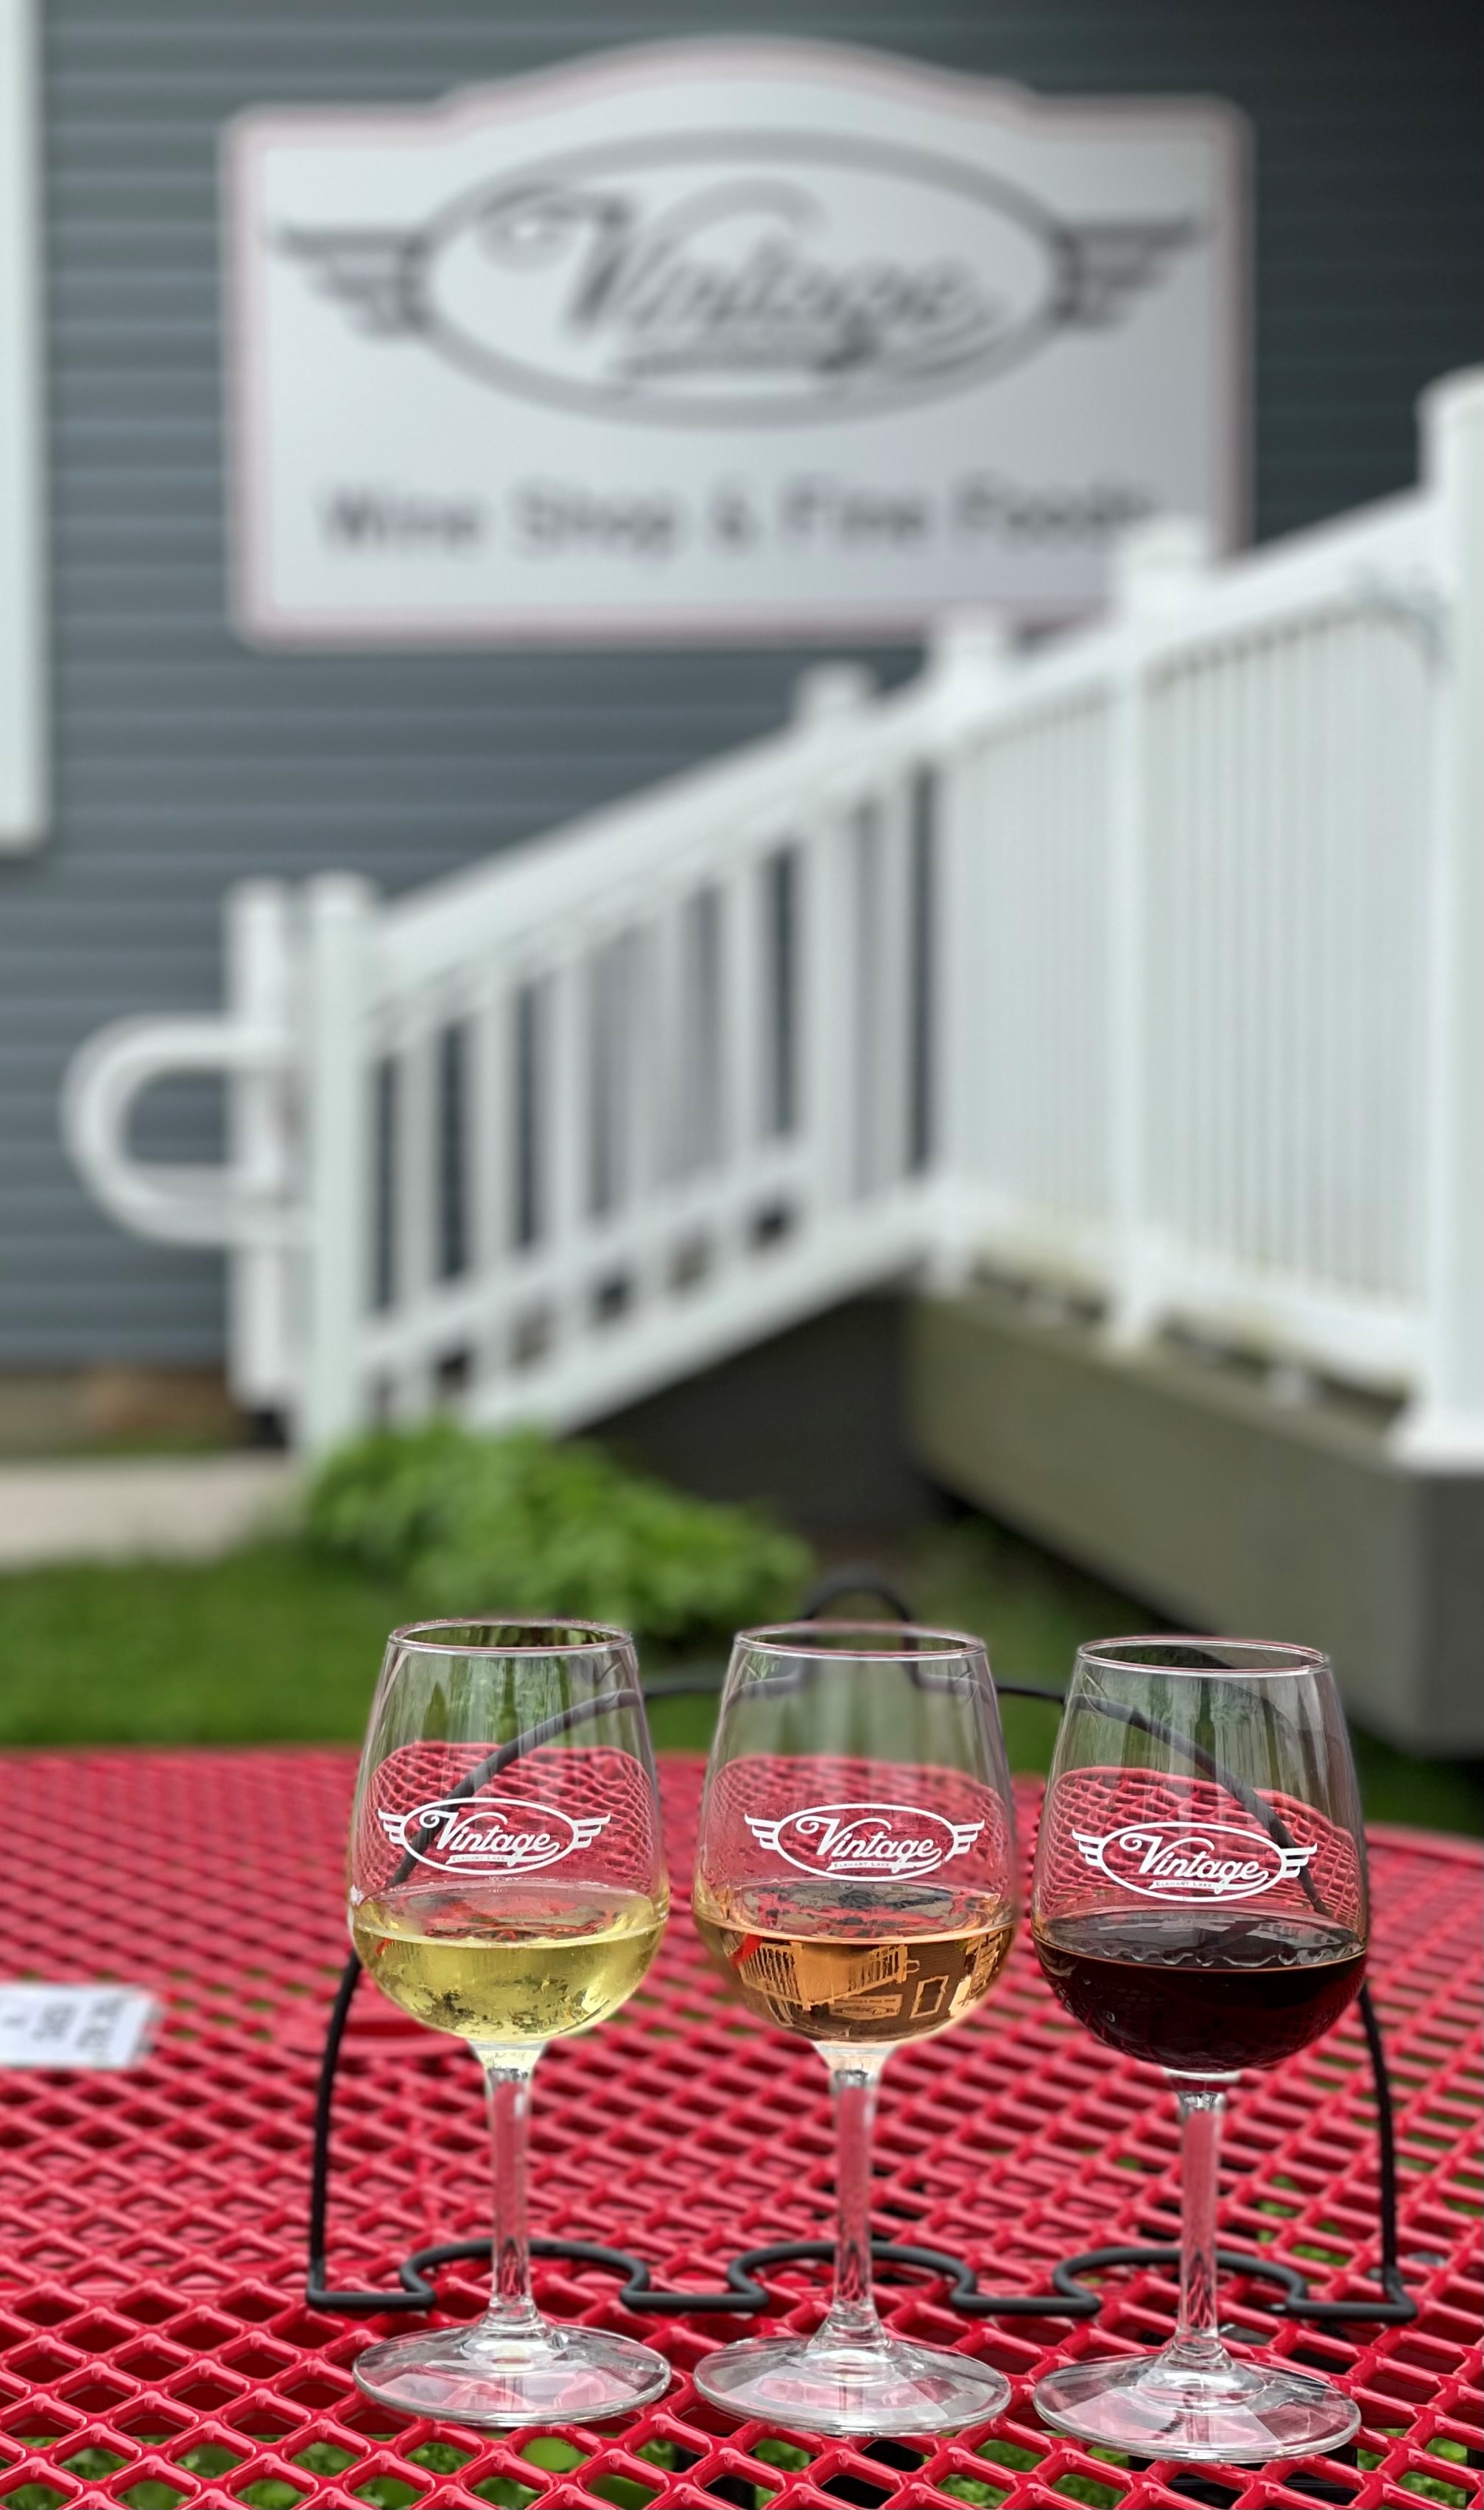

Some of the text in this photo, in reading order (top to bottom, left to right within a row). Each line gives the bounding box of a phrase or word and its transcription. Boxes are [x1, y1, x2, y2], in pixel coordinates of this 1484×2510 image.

[471, 178, 998, 377] Vintage
[322, 483, 482, 554] Wine
[516, 479, 679, 571] Shop
[419, 1809, 560, 1867] Vintage
[795, 1815, 942, 1873] Vintage
[1119, 1832, 1269, 1894] Vintage
